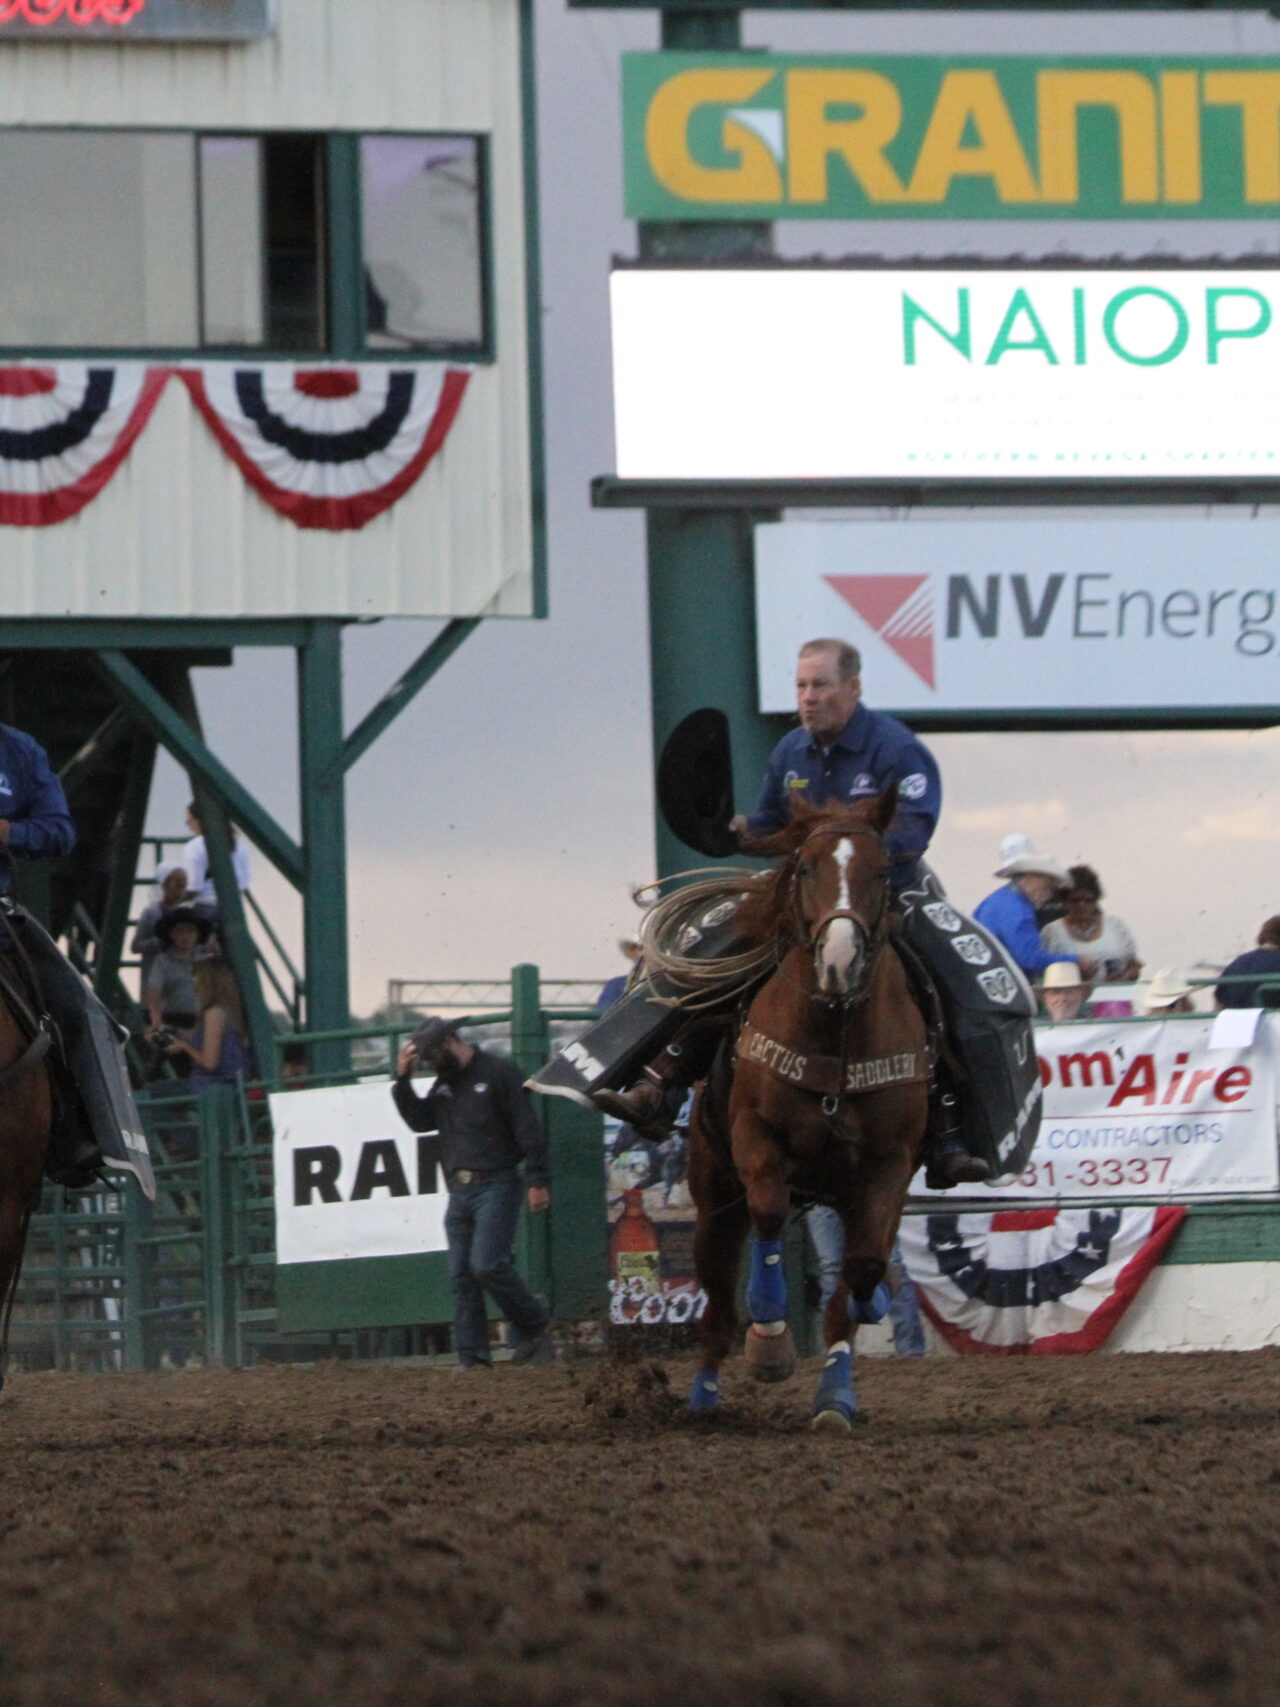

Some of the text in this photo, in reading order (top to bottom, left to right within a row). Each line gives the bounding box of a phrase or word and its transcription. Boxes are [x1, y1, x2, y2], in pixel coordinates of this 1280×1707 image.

[644, 67, 1280, 205] GRANIT
[901, 285, 1272, 367] NAIOP
[750, 1033, 808, 1081] CACTUS
[1048, 1122, 1225, 1150] CONTRACTORS
